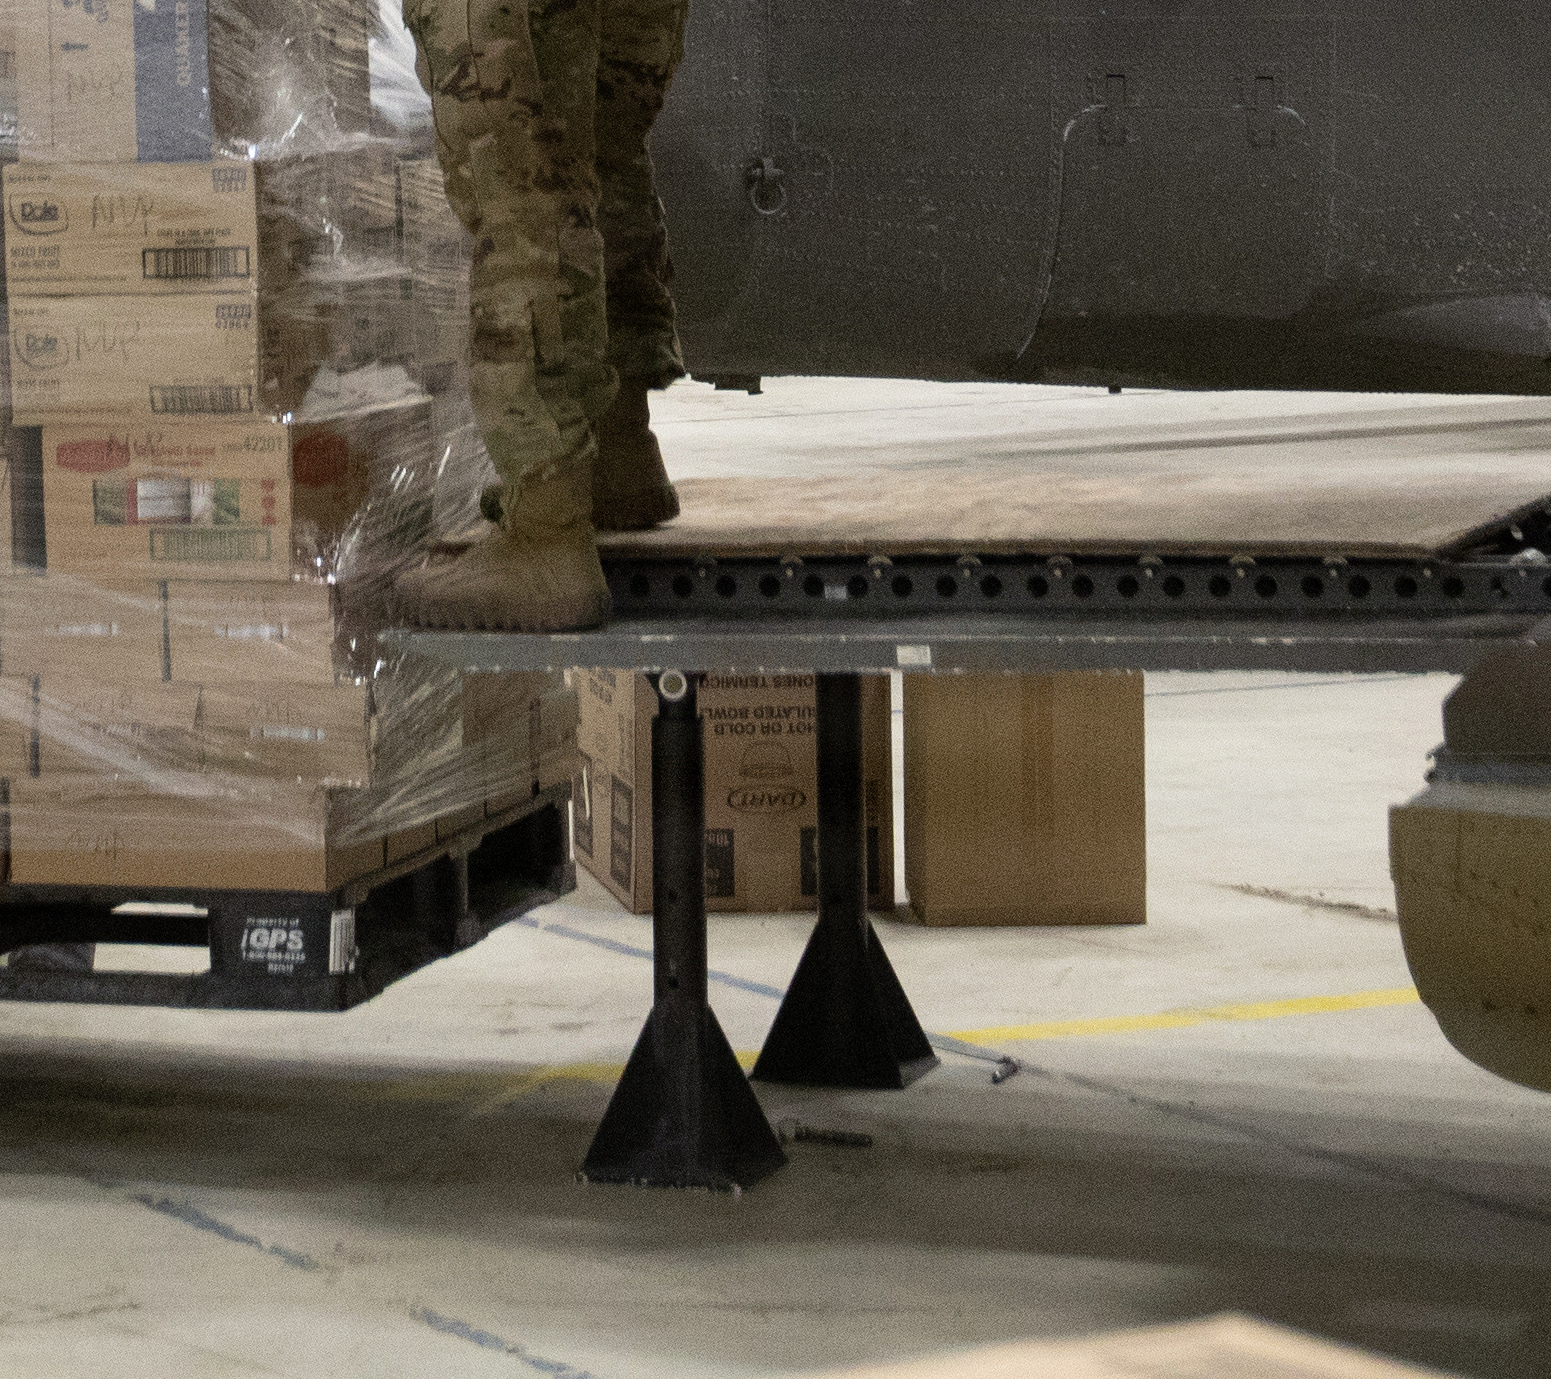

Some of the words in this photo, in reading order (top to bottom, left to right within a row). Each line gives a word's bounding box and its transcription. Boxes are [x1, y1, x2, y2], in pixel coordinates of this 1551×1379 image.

[174, 1, 192, 87] QUAKER
[20, 200, 59, 223] Dole
[771, 674, 816, 688] ONES
[698, 705, 749, 720] BOWL
[753, 705, 817, 720] ULATED
[714, 722, 757, 735] COLD
[760, 722, 782, 735] OR
[787, 722, 816, 735] HOT
[738, 792, 797, 808] DART
